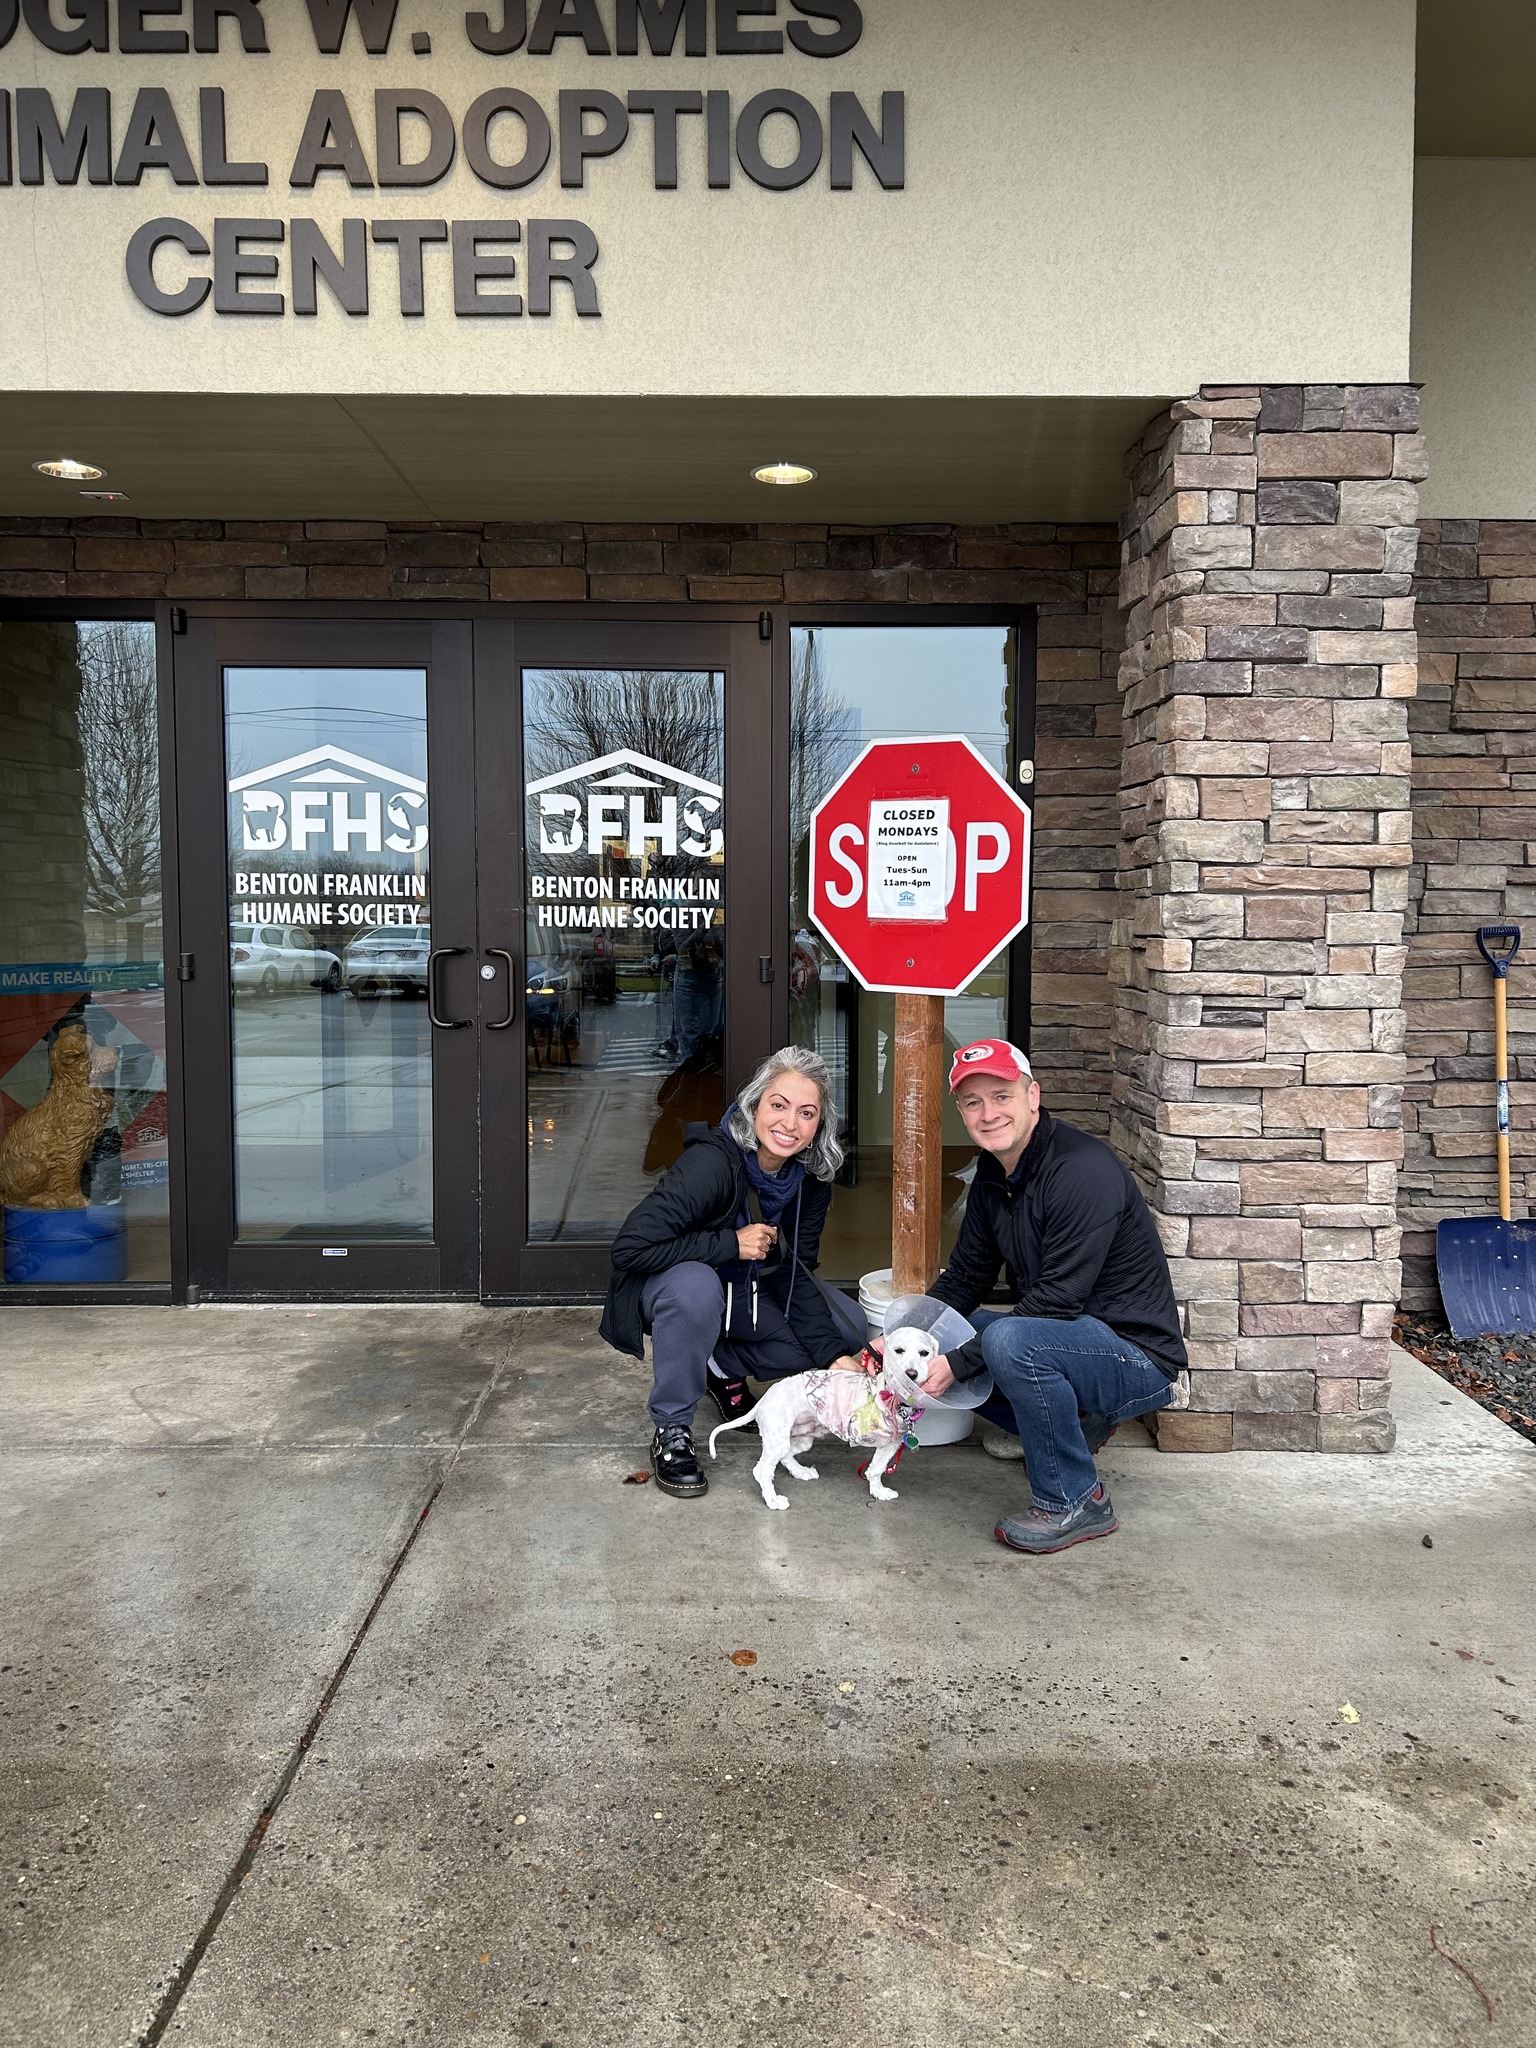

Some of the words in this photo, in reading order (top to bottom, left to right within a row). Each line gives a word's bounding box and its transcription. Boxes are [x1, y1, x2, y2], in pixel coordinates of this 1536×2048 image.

[0, 0, 270, 55] GER
[306, 0, 431, 54] W.
[466, 0, 863, 58] JAMES
[289, 87, 905, 190] ADOPTION
[126, 217, 602, 317] CENTER
[242, 790, 429, 853] BFHS
[539, 793, 724, 857] BFHS
[883, 809, 935, 820] CLOSED
[878, 827, 938, 836] MONDAYS
[825, 821, 1010, 912] SP
[886, 866, 928, 874] Tues-Sun
[235, 872, 317, 895] BENTON
[323, 874, 426, 897] FRANKLIN
[531, 875, 613, 899] BENTON
[619, 877, 720, 900] FRANKLIN
[883, 879, 931, 888] 11am-4pm
[242, 902, 332, 925] HUMANE
[337, 903, 421, 926] SOCIETY
[538, 905, 628, 928] HUMANE
[632, 907, 715, 929] SOCIETY
[2, 972, 50, 986] MAKE
[53, 970, 114, 984] REALITY
